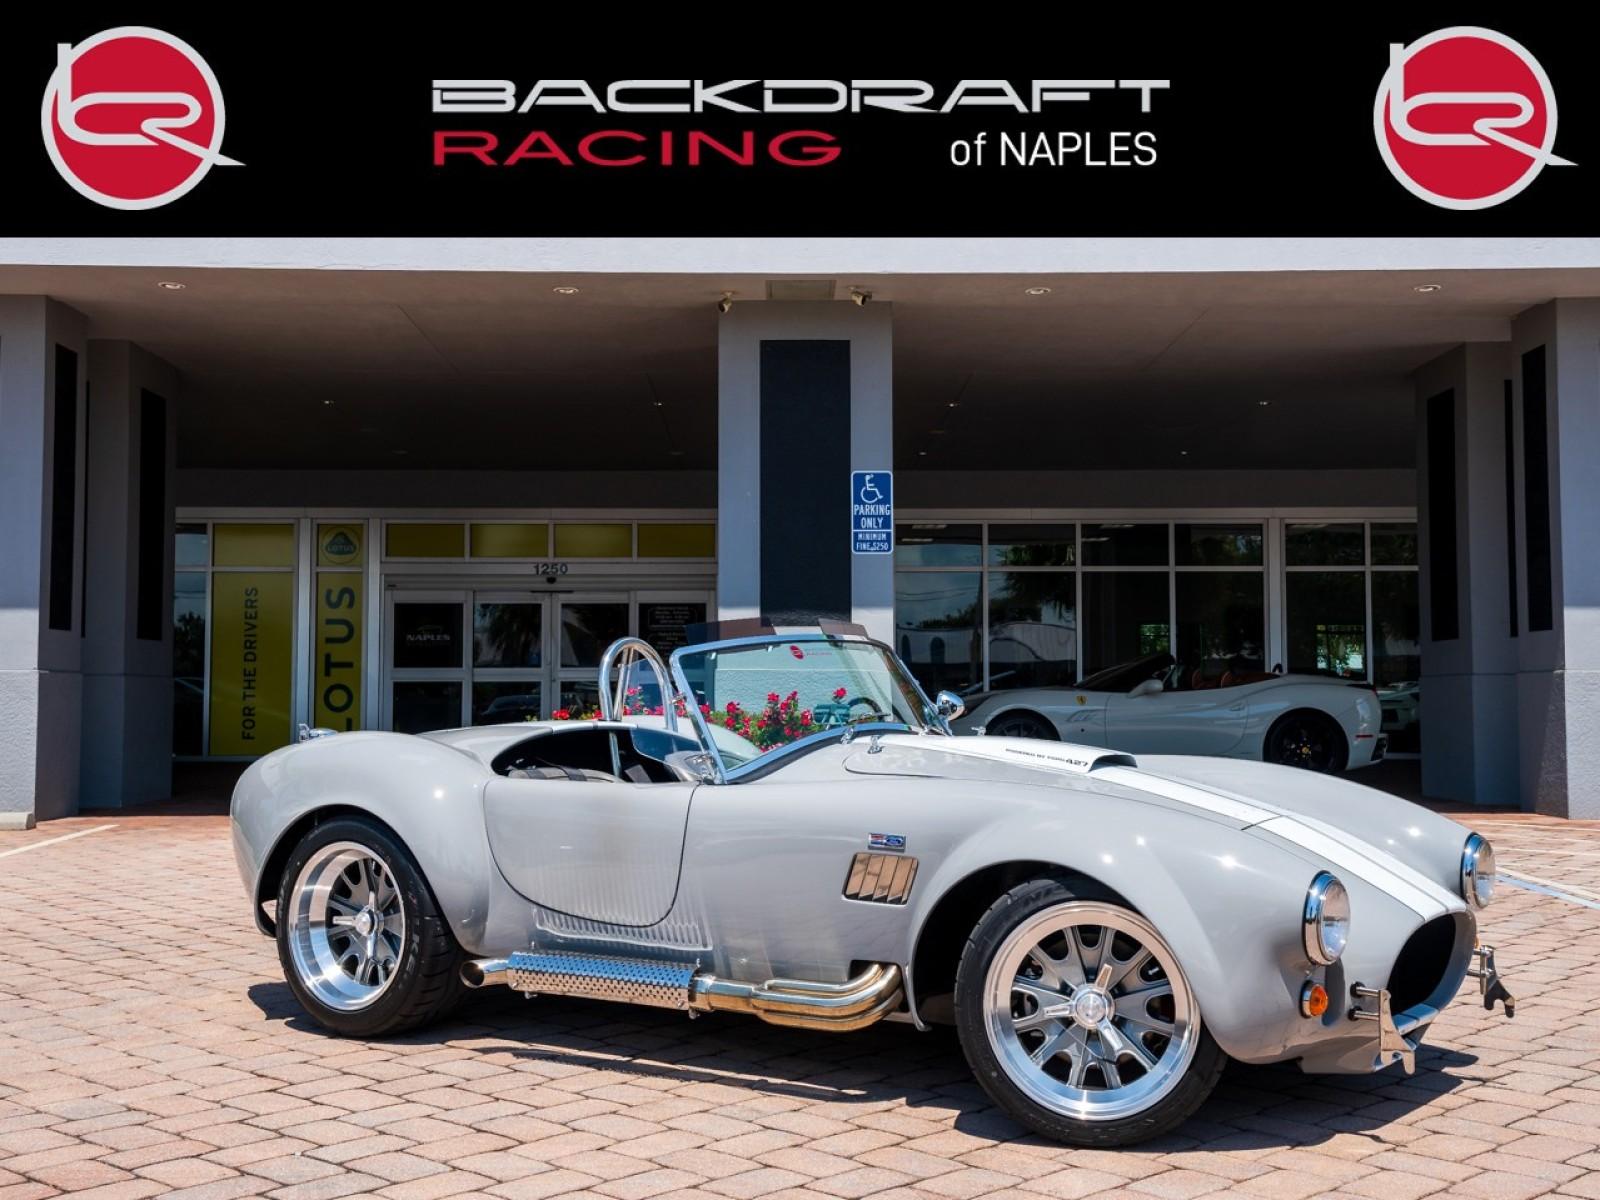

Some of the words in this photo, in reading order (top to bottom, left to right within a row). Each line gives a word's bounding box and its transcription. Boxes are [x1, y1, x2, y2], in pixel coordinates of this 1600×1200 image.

[854, 504, 891, 516] PARKING
[861, 517, 883, 529] ONLY
[858, 533, 886, 541] MINIMUM
[533, 562, 568, 576] 1250
[244, 587, 258, 663] DRIVERS
[243, 668, 257, 701] THE
[242, 709, 256, 740] FOR
[1066, 758, 1088, 767] 427
